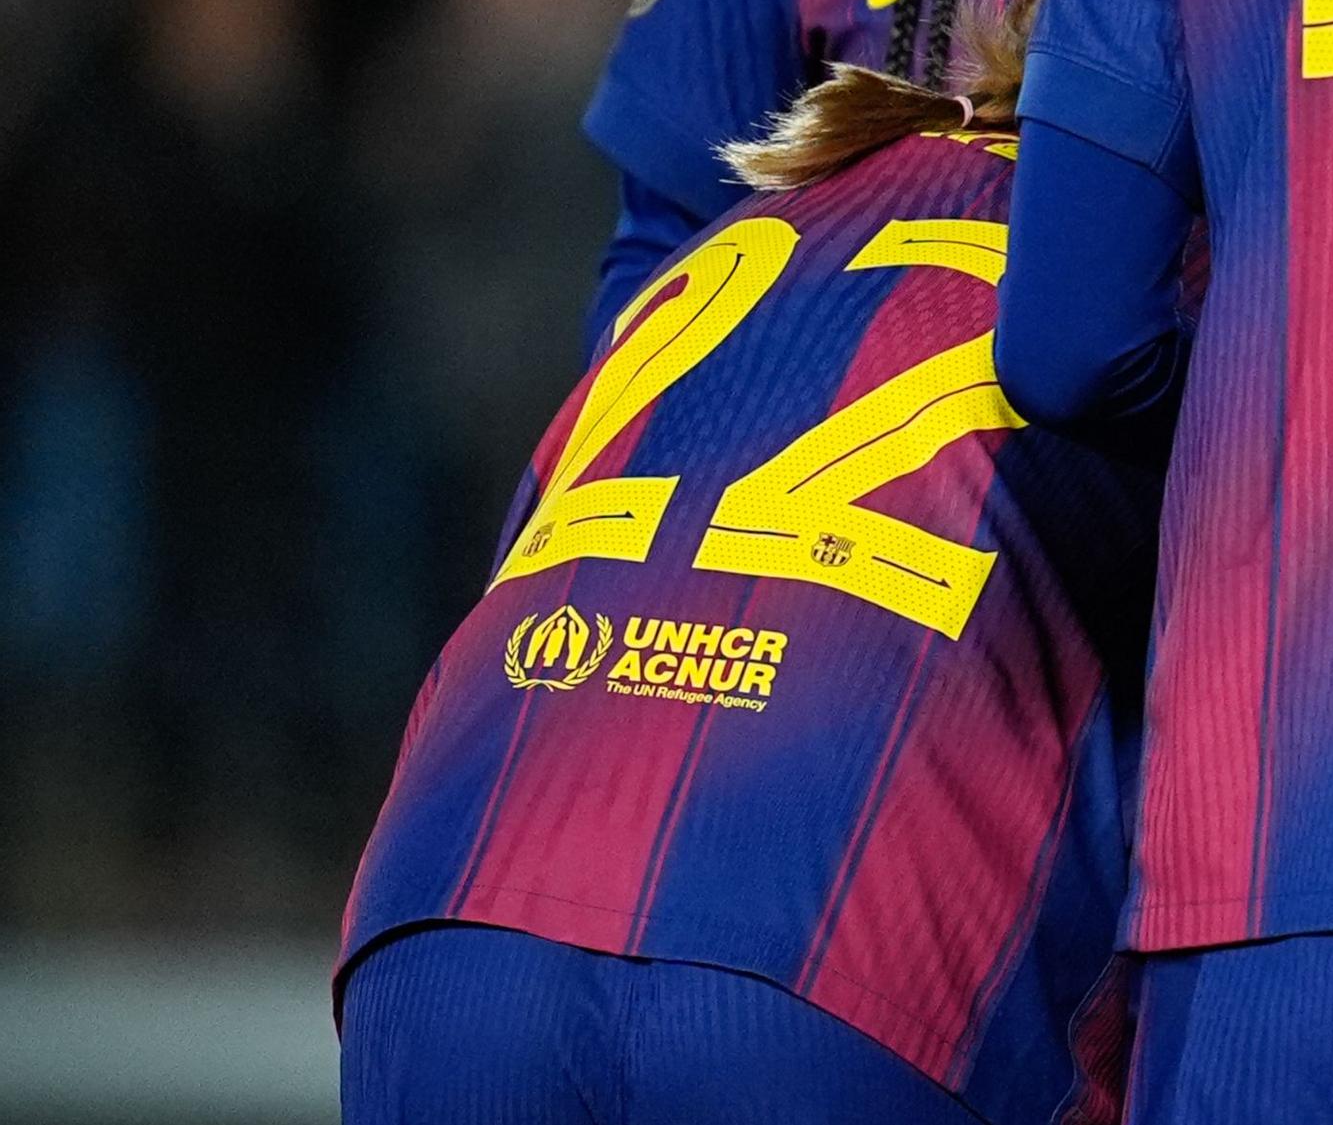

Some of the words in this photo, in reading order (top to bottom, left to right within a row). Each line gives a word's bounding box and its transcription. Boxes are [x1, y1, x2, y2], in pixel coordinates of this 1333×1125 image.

[485, 216, 1029, 642] 22
[623, 616, 789, 664] UNHCR
[606, 649, 777, 697] ACNUR
[606, 680, 632, 694] The
[633, 683, 658, 697] UN
[656, 686, 713, 704] Refugee
[713, 692, 768, 712] Agency
